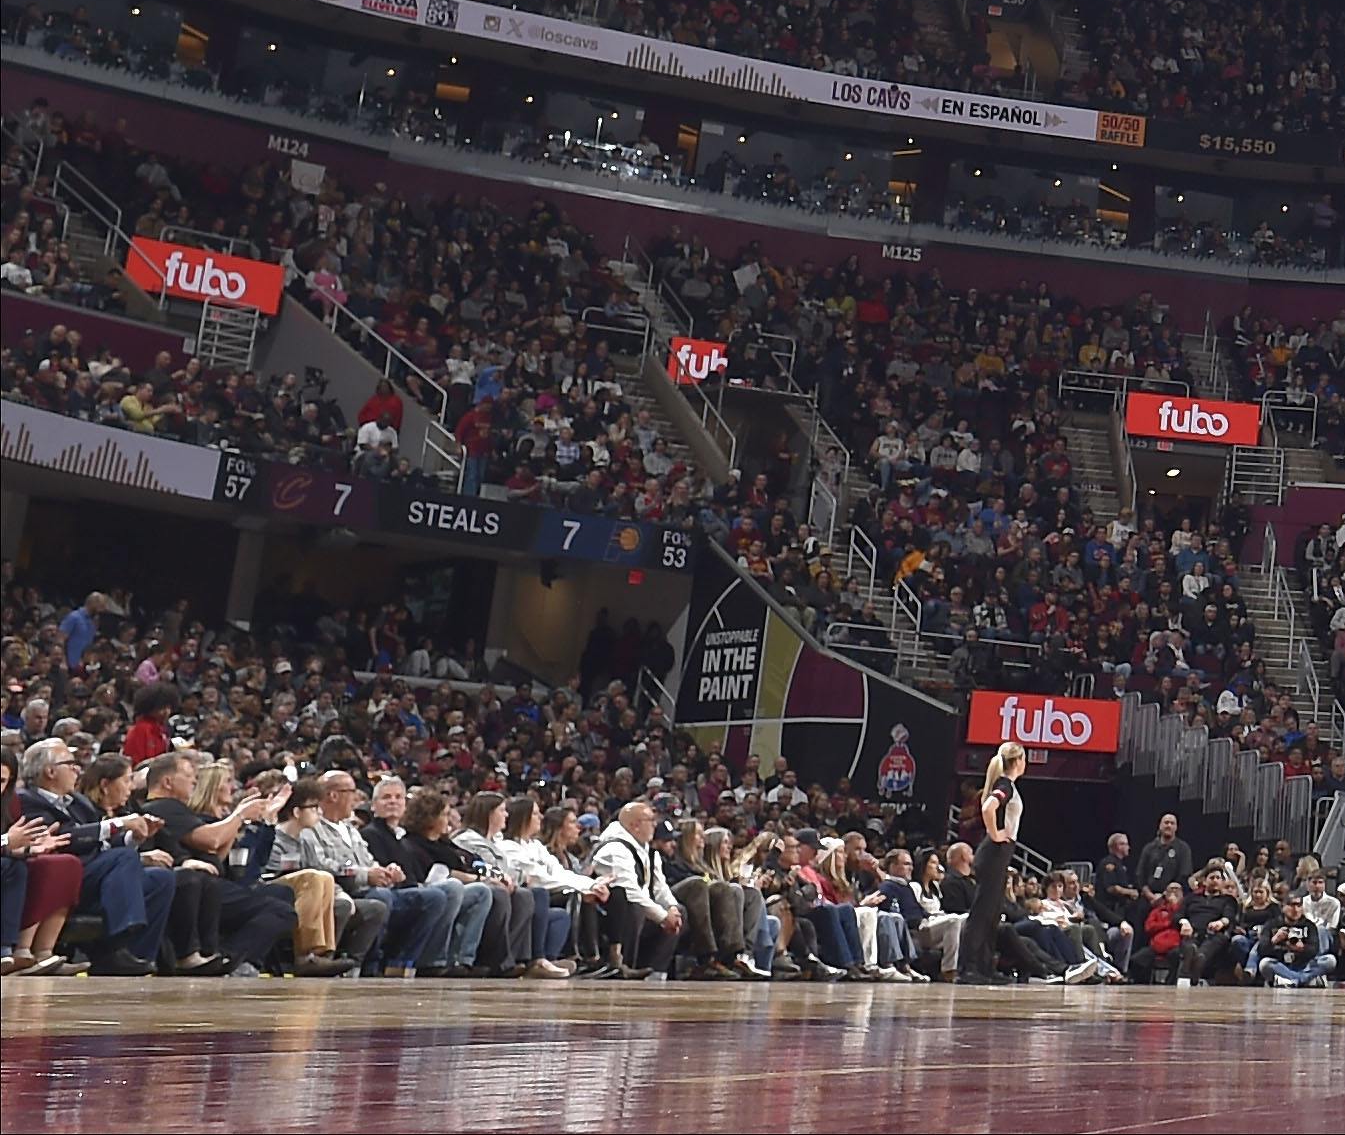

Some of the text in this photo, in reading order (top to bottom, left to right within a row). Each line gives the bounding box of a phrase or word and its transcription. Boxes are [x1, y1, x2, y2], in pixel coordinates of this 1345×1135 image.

[831, 81, 1042, 127] LOS CAVS EN ESPAÑOL
[1102, 114, 1140, 131] 50/50
[268, 135, 309, 156] M124
[1100, 128, 1139, 144] RAFFLE
[1200, 133, 1276, 155] $15,550
[882, 245, 922, 262] M125
[165, 251, 246, 299] fubo
[1158, 400, 1229, 436] fubo
[224, 475, 580, 550] 57 7 STEALS 7
[662, 546, 687, 568] 53
[705, 628, 759, 646] UNSTOPPABLE
[702, 646, 756, 673] IN THE
[698, 674, 753, 702] PAINT
[1000, 696, 1092, 746] fubo
